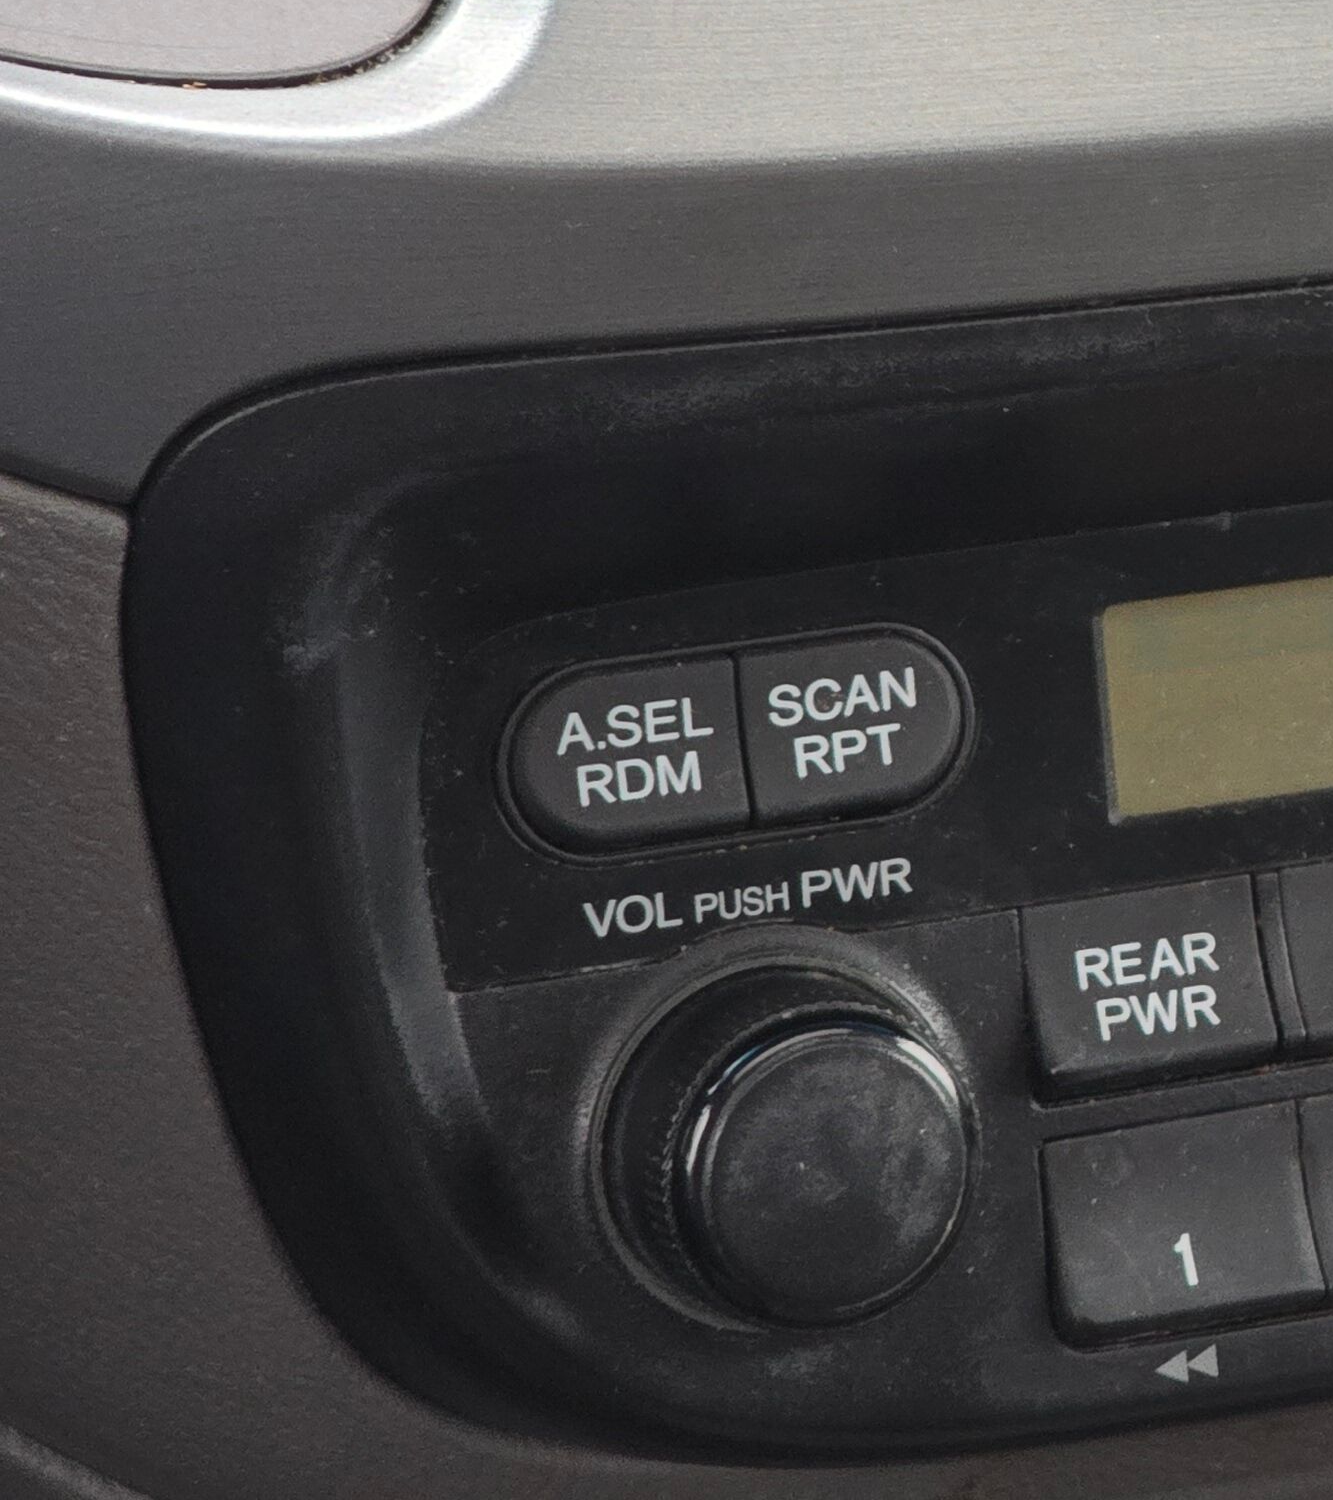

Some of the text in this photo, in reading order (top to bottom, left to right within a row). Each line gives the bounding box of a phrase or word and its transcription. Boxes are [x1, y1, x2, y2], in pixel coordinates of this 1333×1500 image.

[555, 696, 715, 754] A.SEL
[767, 665, 918, 727] SCAN
[575, 749, 703, 808] RDM
[790, 722, 902, 780] RPT
[581, 856, 914, 939] VOL PUSH PWR
[1074, 931, 1221, 990] REAR
[1094, 986, 1222, 1042] PWR
[1172, 1231, 1200, 1287] 1
